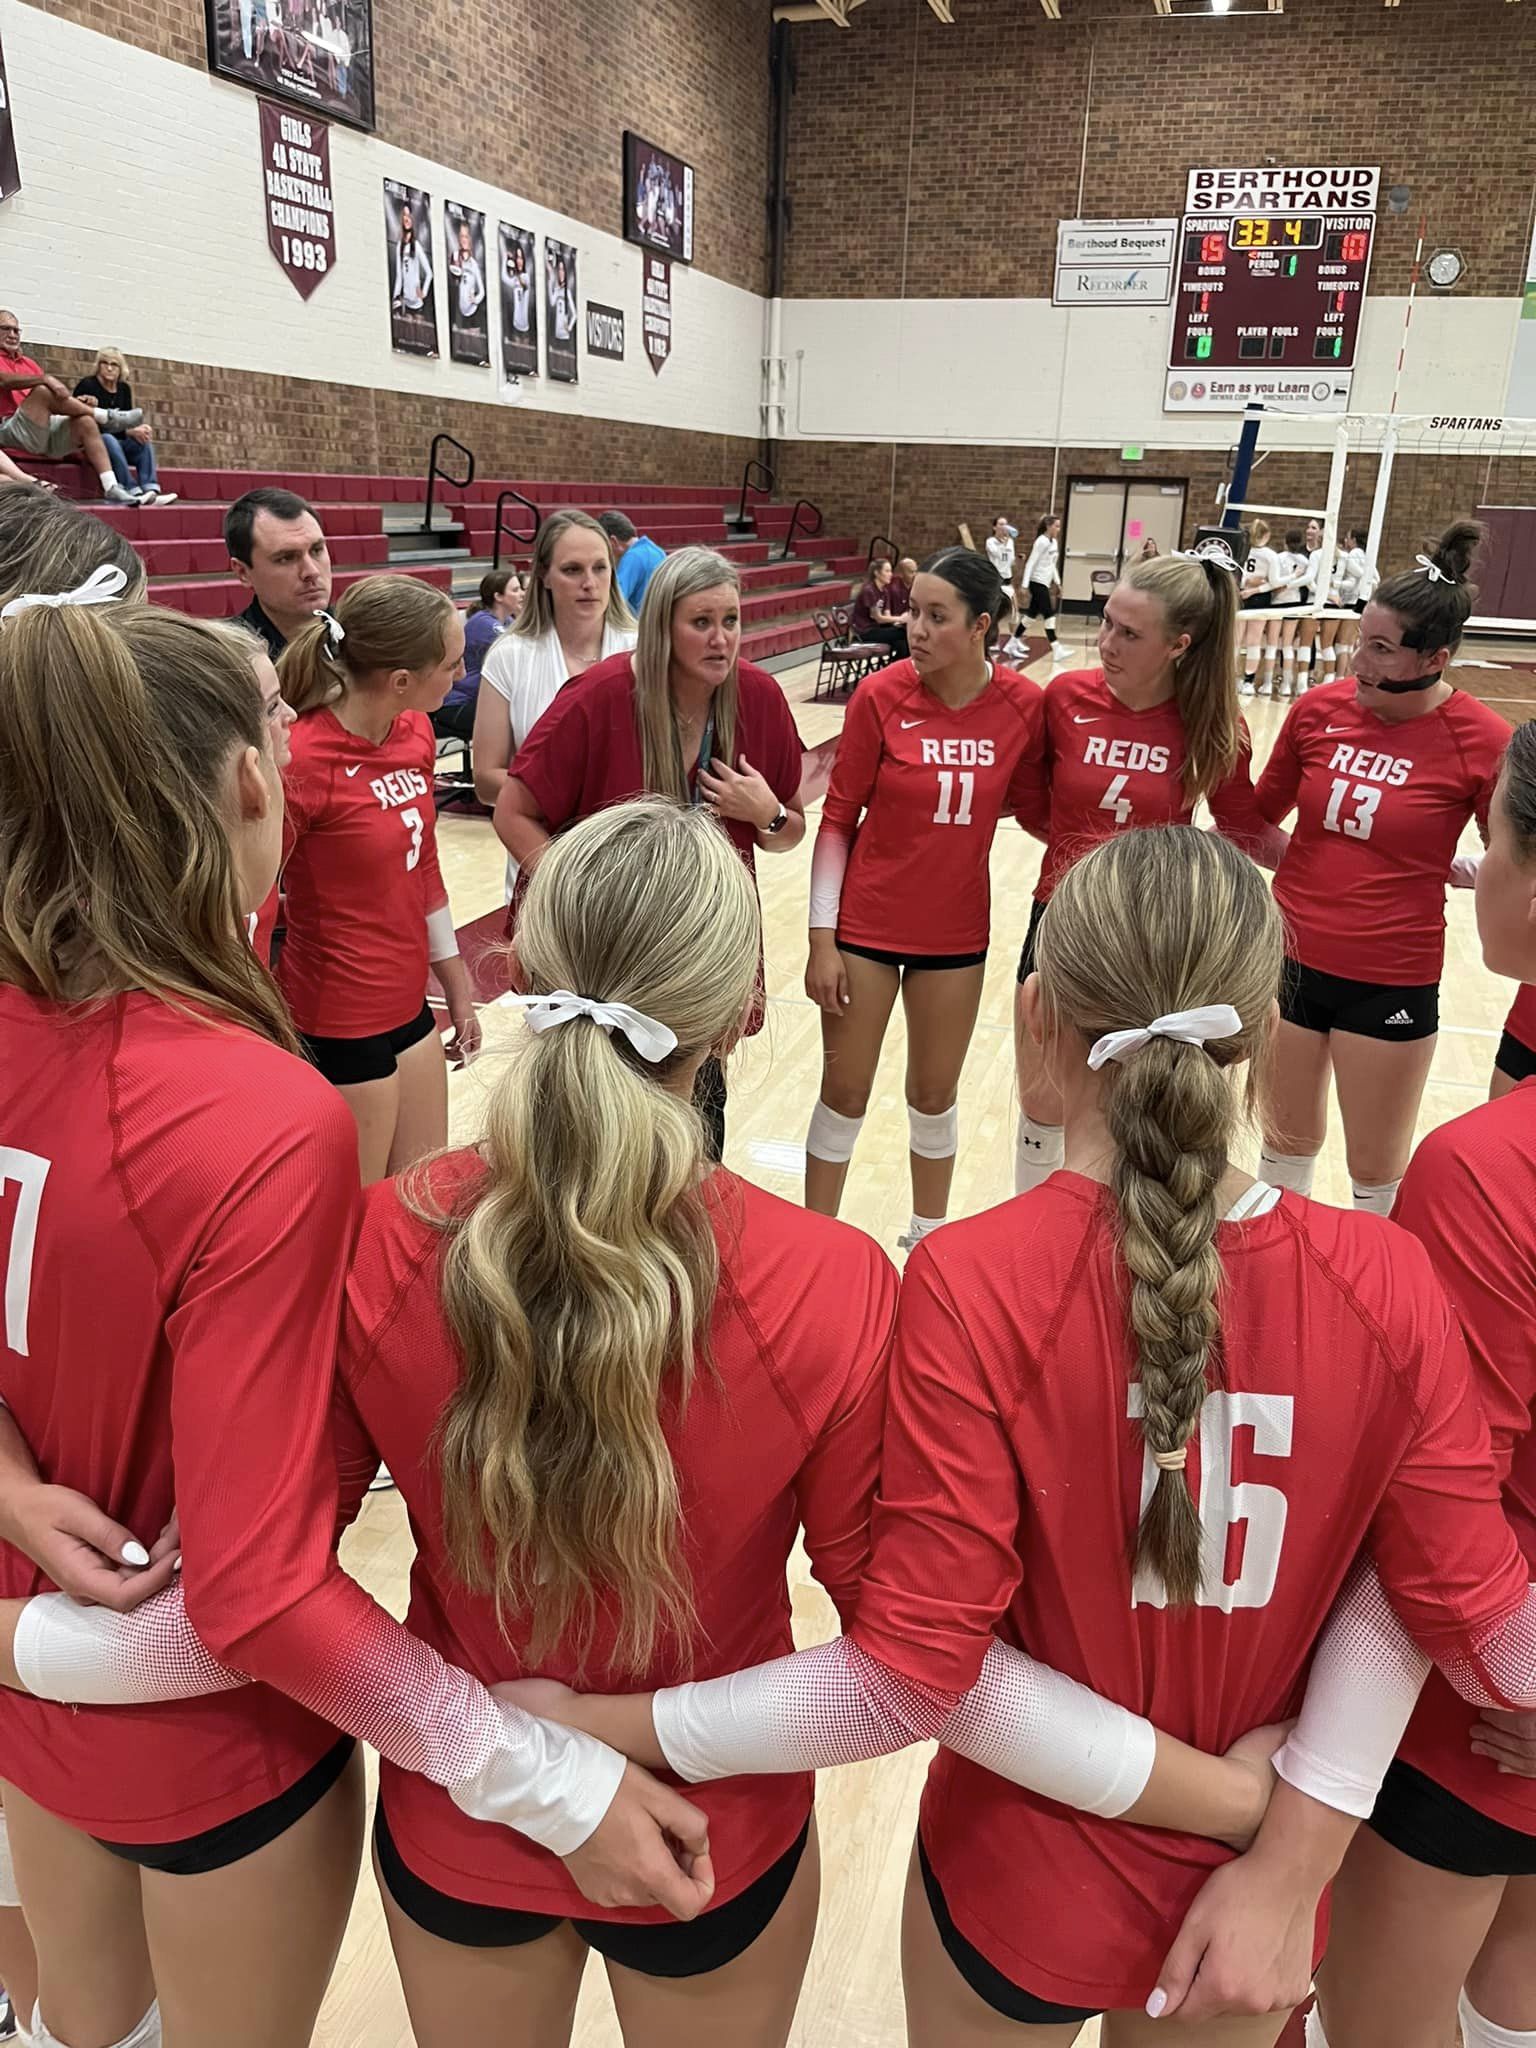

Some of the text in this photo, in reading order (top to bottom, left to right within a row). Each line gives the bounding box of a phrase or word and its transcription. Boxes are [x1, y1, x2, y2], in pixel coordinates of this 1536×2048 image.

[280, 114, 312, 149] GIRLS
[272, 142, 323, 181] 4A STATE
[1195, 170, 1373, 189] BERTHOUD
[266, 169, 333, 212] BASKETBALL
[1193, 191, 1371, 210] SPARTANS
[270, 200, 330, 239] CHAMPIONS
[1185, 219, 1230, 232] SPARTANS
[1326, 217, 1371, 231] VISITOR
[281, 235, 328, 273] 1993
[1068, 238, 1166, 251] Berthoud Bequest
[1201, 234, 1224, 262] 15
[1197, 266, 1226, 276] BONUS
[1248, 259, 1280, 269] PERIOD
[1317, 265, 1347, 275] BONUS
[1183, 282, 1224, 292] TIMEOUTS
[1317, 281, 1360, 291] TIMEOUTS
[1188, 313, 1209, 323] LEFT
[1323, 313, 1345, 322] LEFT
[588, 311, 623, 352] VISITORS
[1237, 326, 1299, 336] PLAYER FOULS
[1316, 327, 1344, 336] FOULS
[1210, 381, 1311, 397] Earn as you Learn
[1430, 416, 1503, 431] SPARTANS
[920, 738, 996, 767] REDS
[1083, 736, 1171, 774] REDS
[1328, 743, 1413, 786] REDS
[369, 768, 428, 811] REDS
[932, 770, 975, 826] 11
[1098, 774, 1133, 824] 4
[1323, 778, 1383, 841] 13
[400, 807, 424, 872] 3
